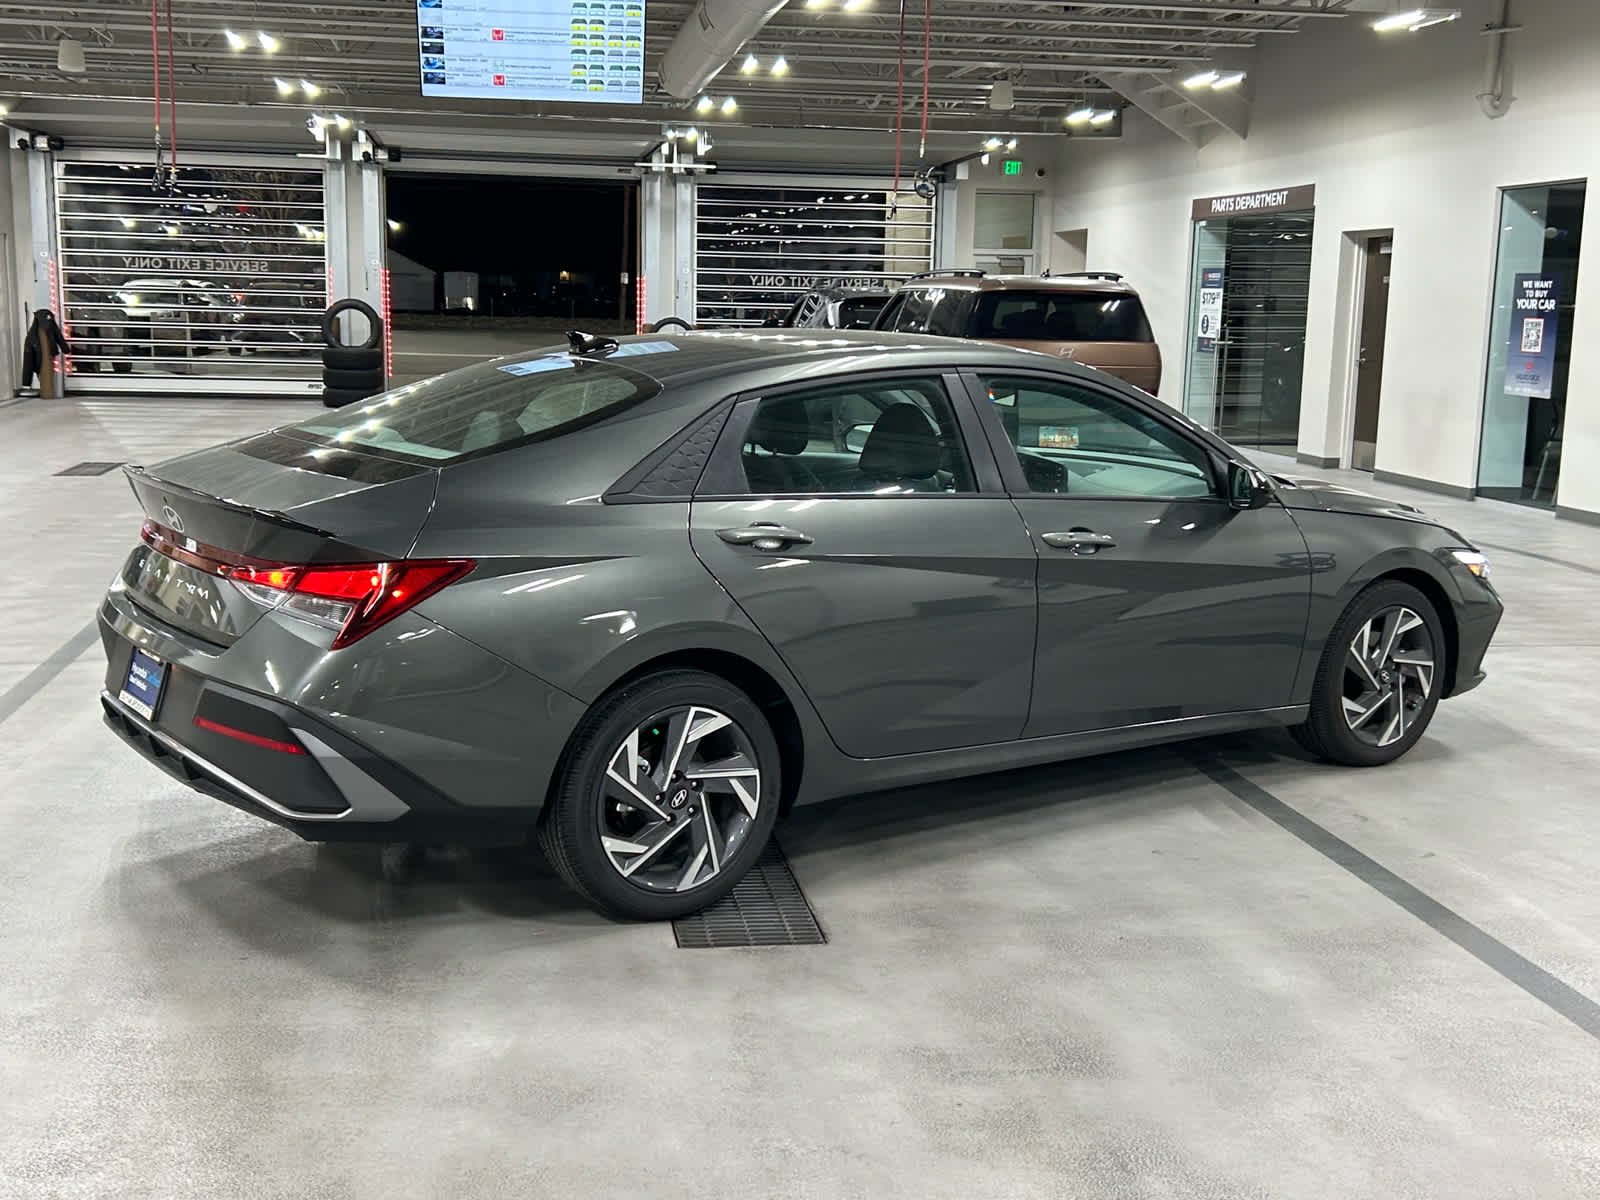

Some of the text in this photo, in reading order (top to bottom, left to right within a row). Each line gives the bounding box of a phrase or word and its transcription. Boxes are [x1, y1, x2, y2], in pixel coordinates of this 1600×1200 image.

[1005, 161, 1022, 175] EXIT
[1211, 191, 1288, 213] PARTS DEPARTMENT
[1522, 280, 1553, 289] WE WANT
[1525, 290, 1548, 298] TO BUY
[1516, 298, 1556, 310] YOUR CAR
[139, 559, 209, 599] ELANTRA
